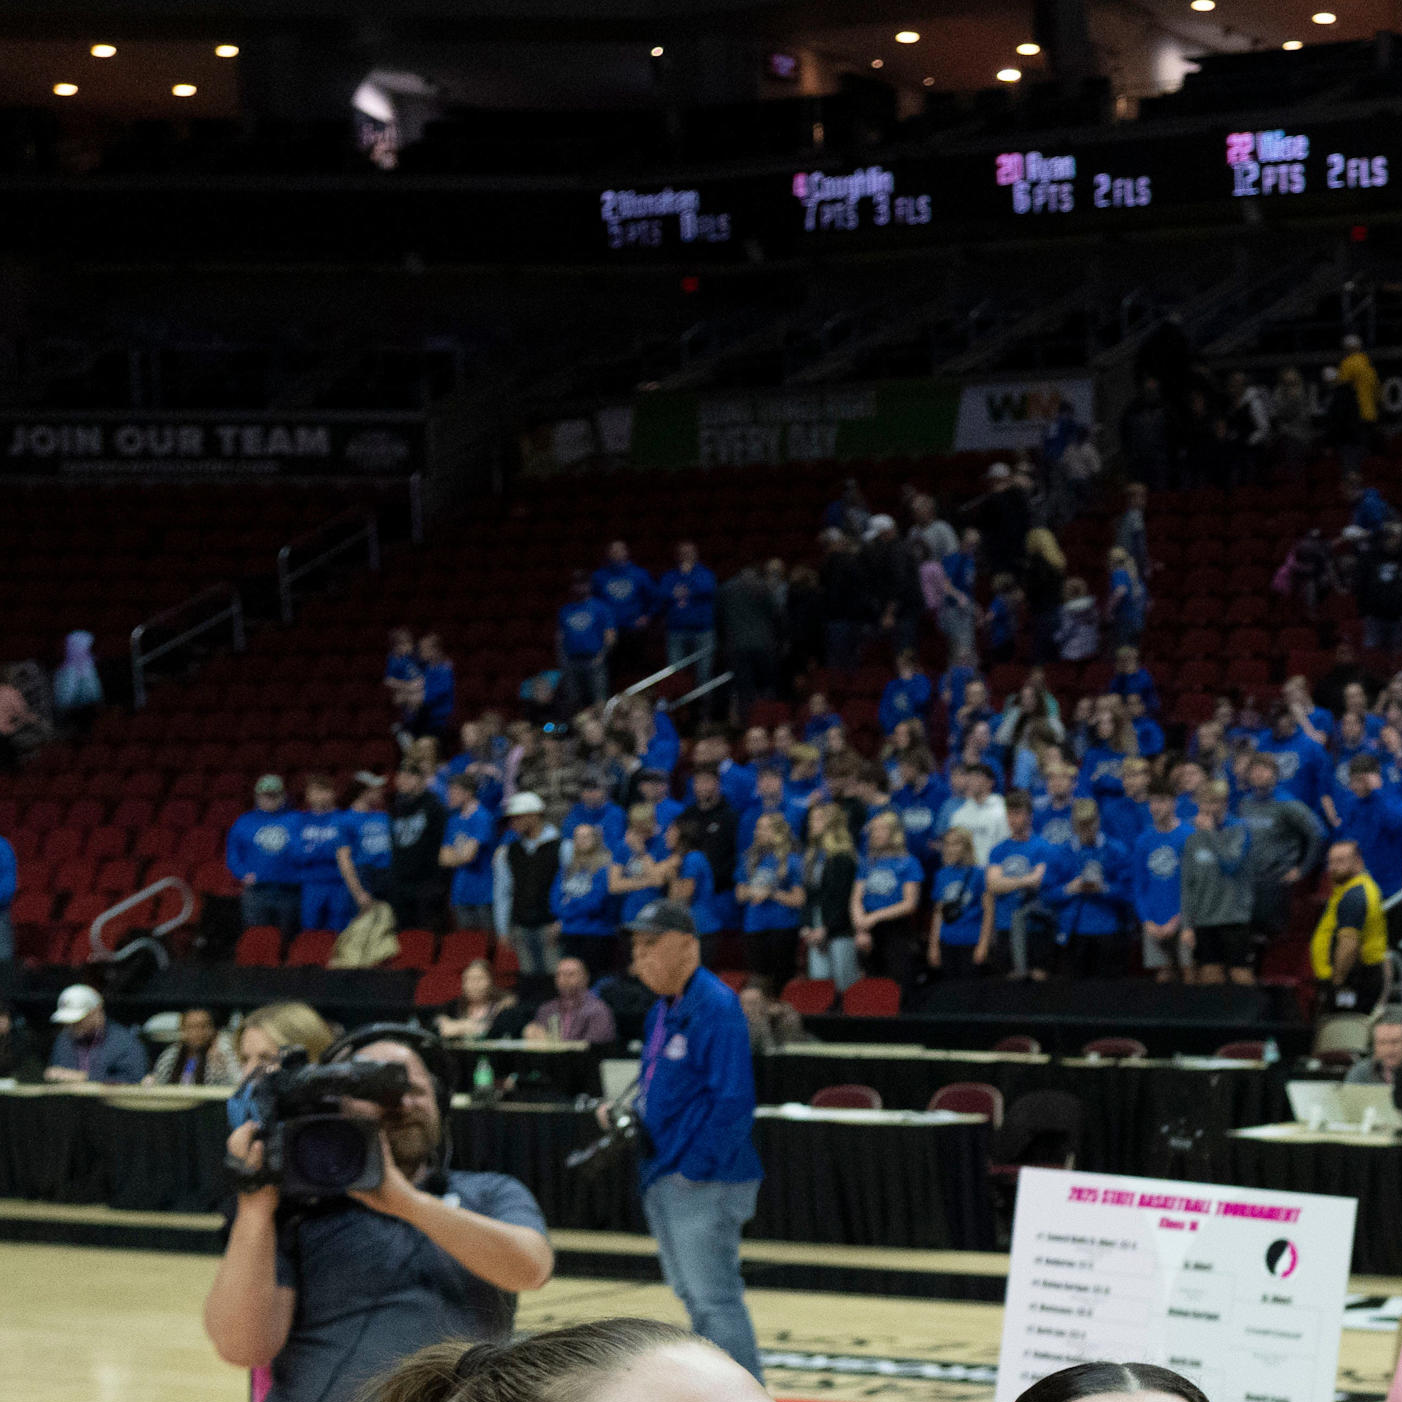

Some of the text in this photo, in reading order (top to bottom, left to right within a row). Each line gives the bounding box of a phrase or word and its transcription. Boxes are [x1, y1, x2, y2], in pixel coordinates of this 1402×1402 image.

[1261, 163, 1305, 195] PTS
[1347, 156, 1388, 188] FLS
[1032, 183, 1075, 214] PTS
[8, 425, 102, 456] JOIN
[114, 425, 203, 456] OUR
[213, 424, 331, 455] TEAM
